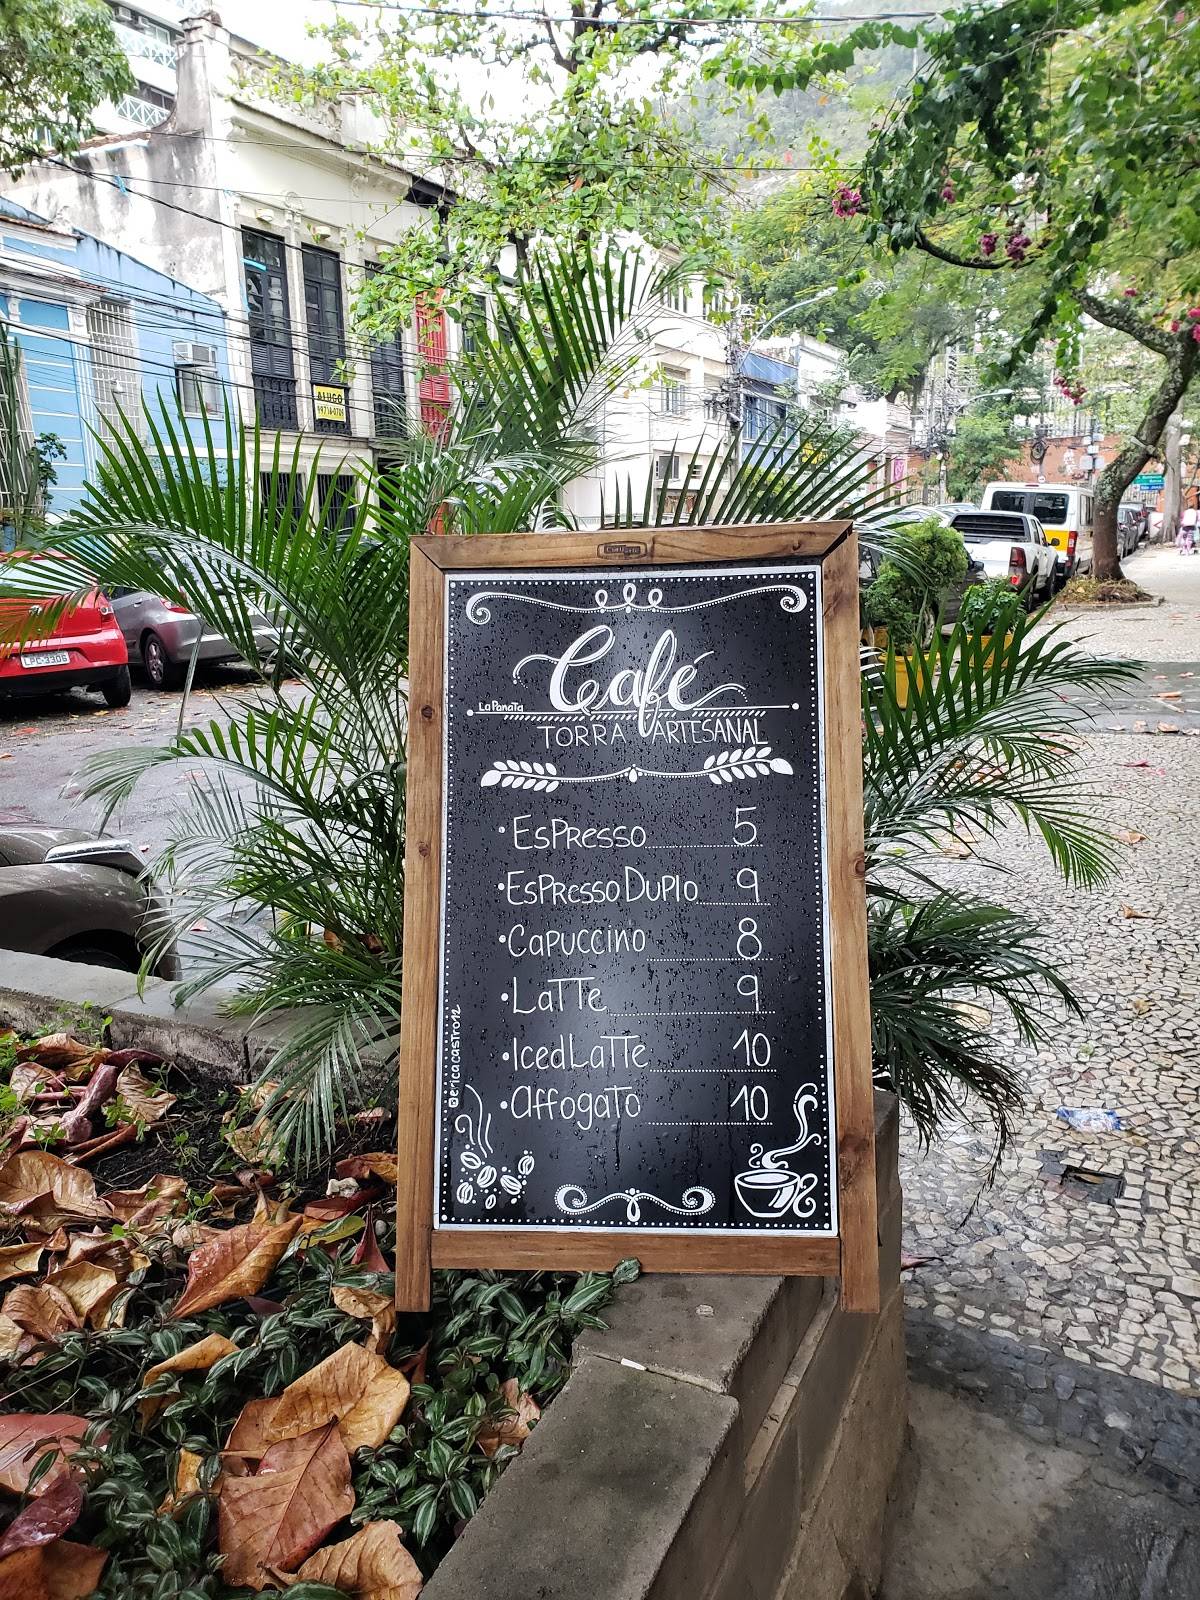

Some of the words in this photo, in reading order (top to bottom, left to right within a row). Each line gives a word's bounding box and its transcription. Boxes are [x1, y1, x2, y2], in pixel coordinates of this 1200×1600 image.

[513, 625, 748, 738] Café
[536, 723, 627, 749] TORRA
[652, 718, 769, 745] ARTESANAL
[732, 806, 758, 846] 5
[736, 867, 761, 903] 9
[736, 917, 763, 960] 8
[736, 974, 760, 1012] 9
[732, 1029, 772, 1068] 10
[730, 1084, 770, 1122] 10
